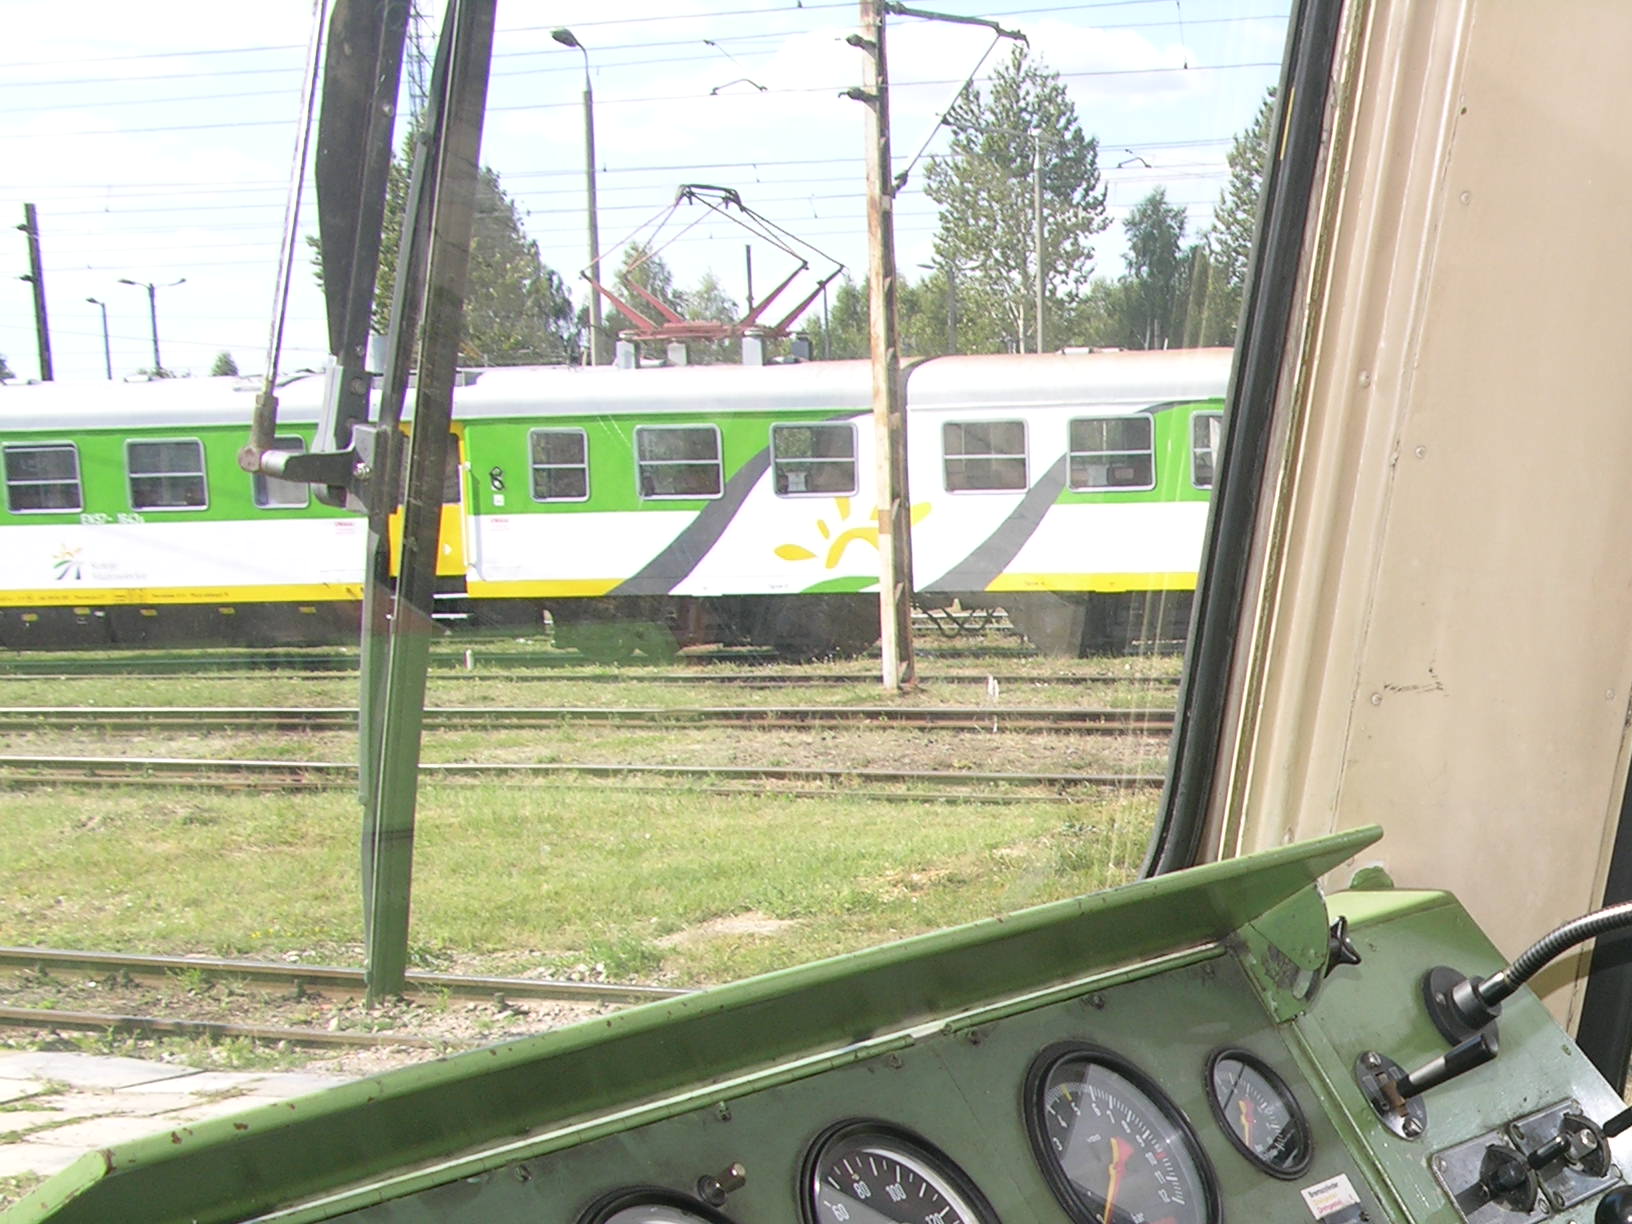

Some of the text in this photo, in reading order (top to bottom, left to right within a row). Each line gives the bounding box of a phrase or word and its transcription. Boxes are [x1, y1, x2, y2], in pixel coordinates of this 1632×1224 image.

[1106, 1109, 1115, 1124] 7
[1154, 1170, 1167, 1184] 11
[853, 1182, 871, 1199] 80
[886, 1183, 907, 1202] 100
[831, 1204, 849, 1222] 60
